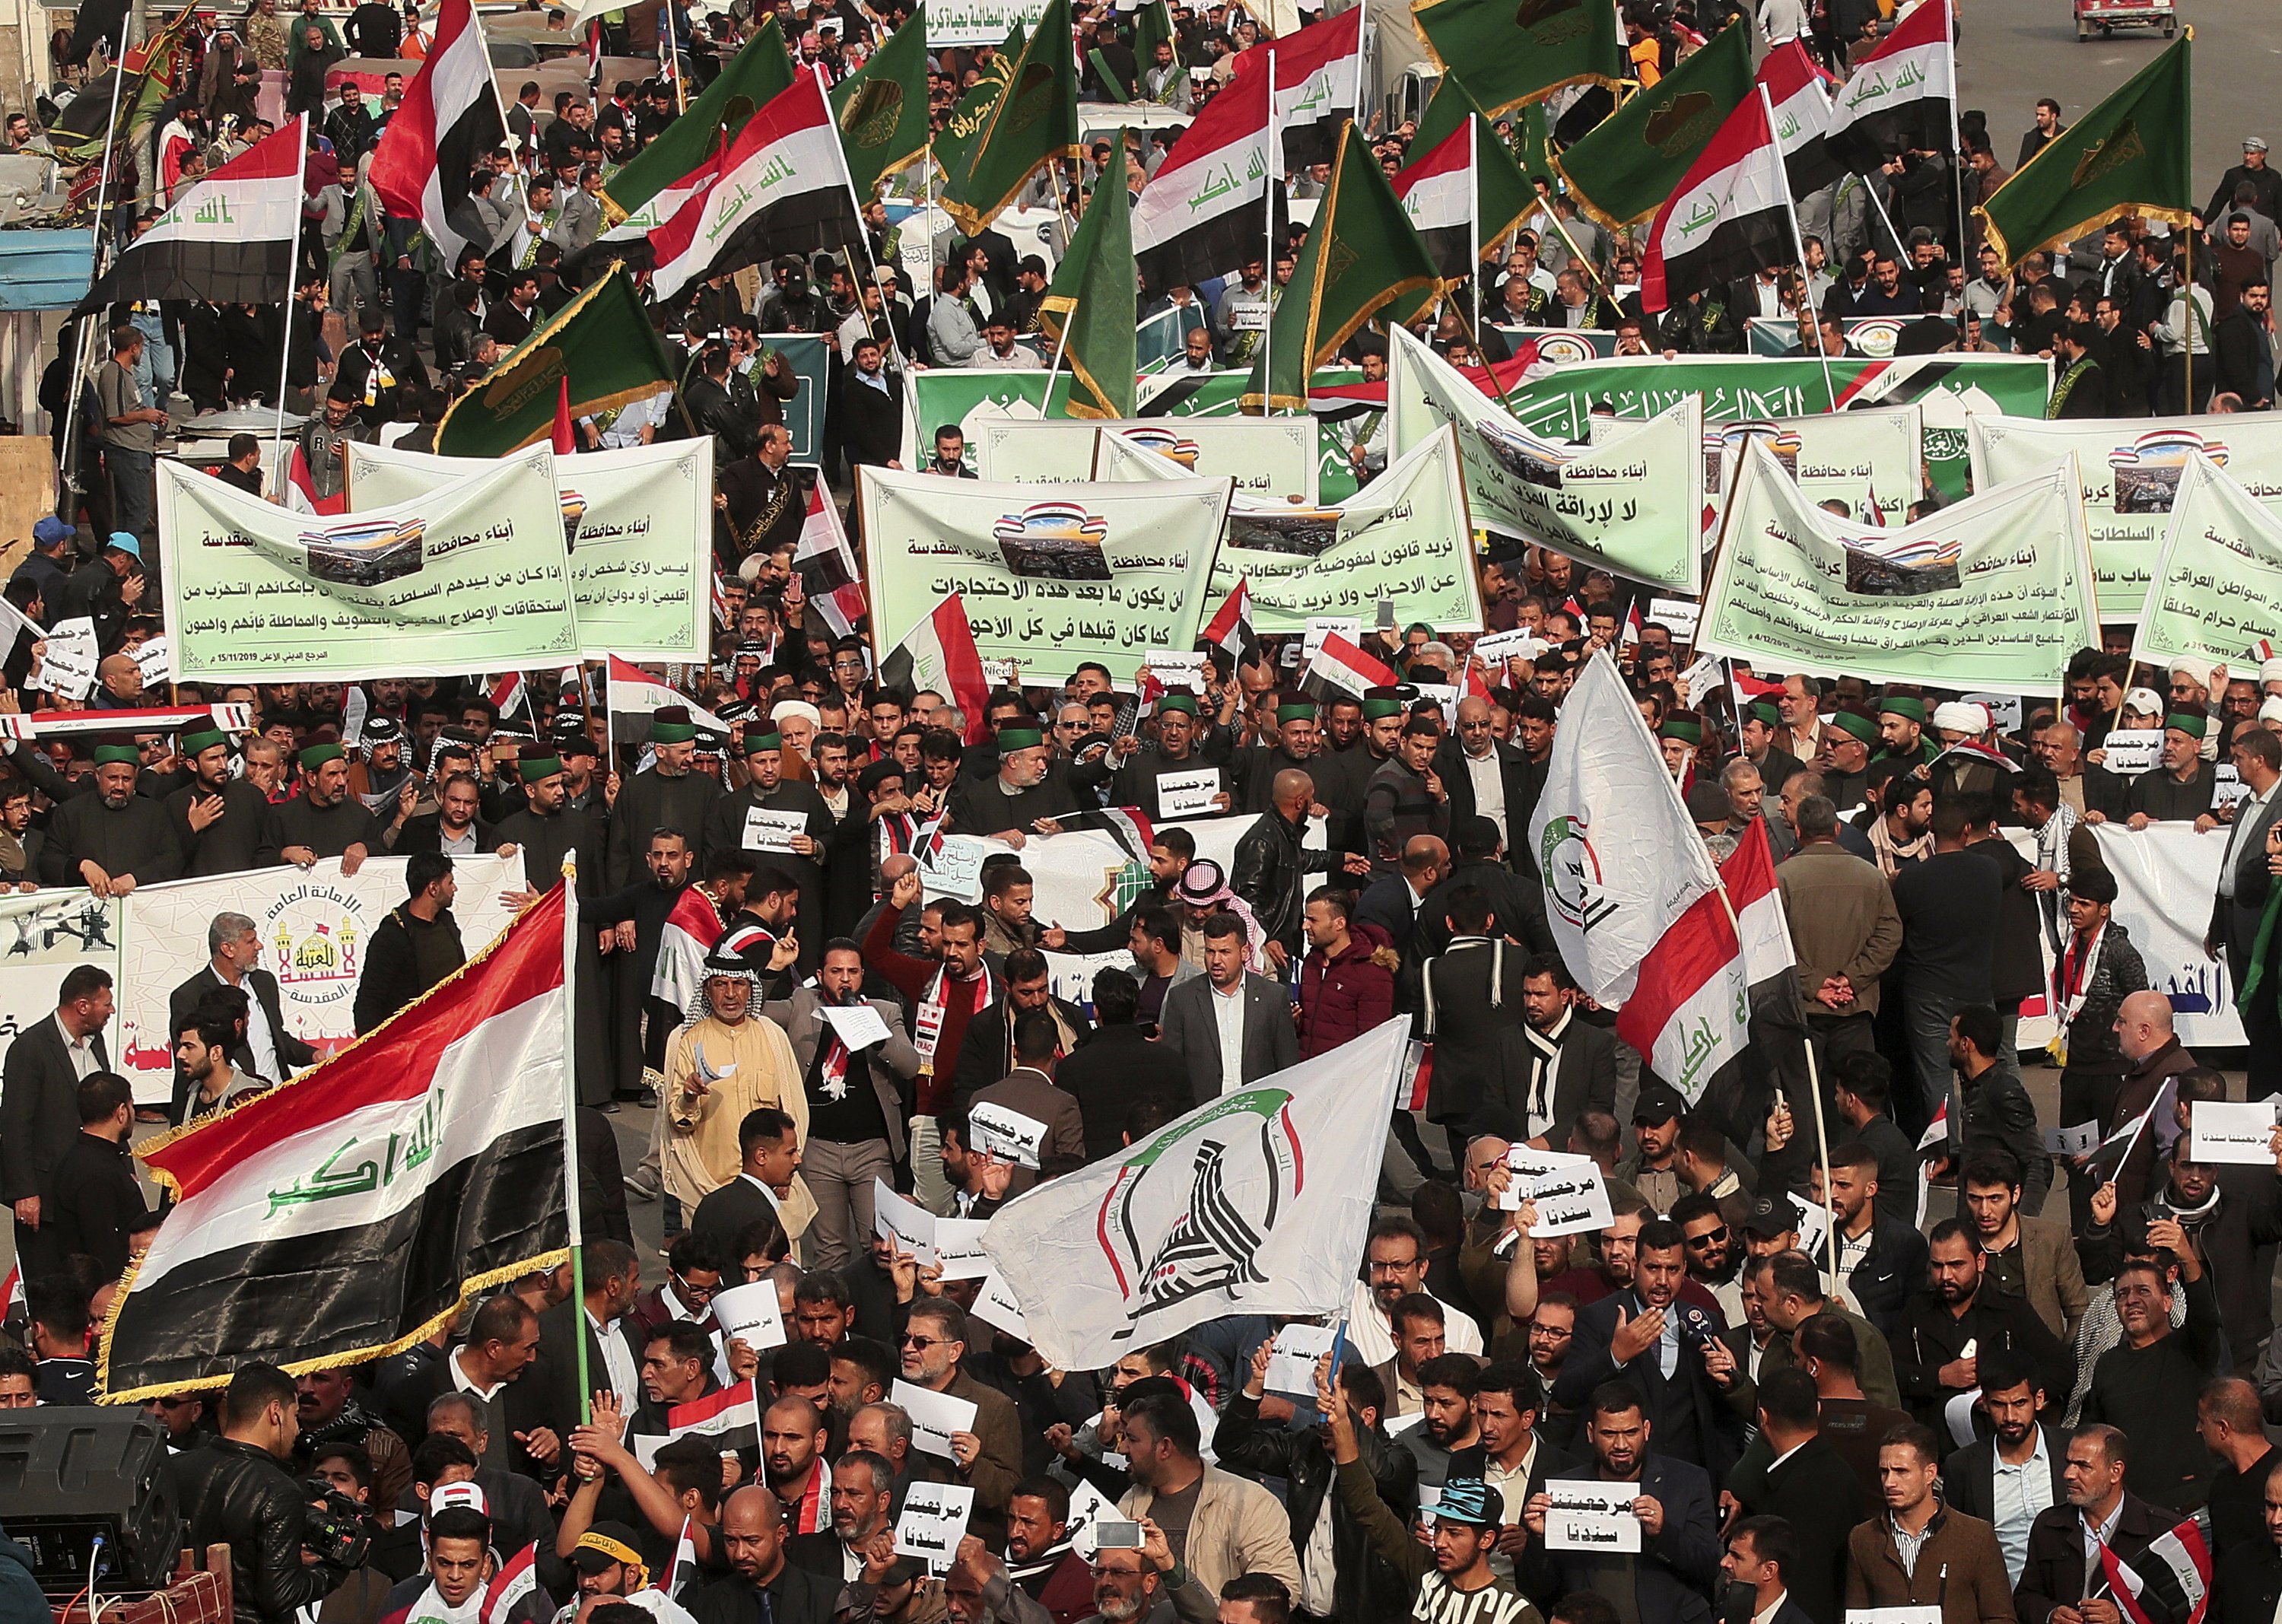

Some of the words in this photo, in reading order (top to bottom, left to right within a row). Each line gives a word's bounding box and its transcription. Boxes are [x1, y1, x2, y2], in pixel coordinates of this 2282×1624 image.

[1565, 464, 1617, 480] محافظة
[1622, 459, 1648, 481] أبناء
[1801, 464, 1846, 478] محافظة
[1851, 462, 1873, 480] أبناء
[1388, 499, 1413, 522] أبناء
[1620, 497, 1637, 523] لا
[485, 518, 513, 542] أبناء
[579, 522, 623, 540] محافظة
[627, 513, 650, 537] أبناء
[2090, 525, 2155, 542] السلطات
[427, 532, 480, 557] محافظة
[907, 538, 962, 557] المقدسة
[966, 546, 1002, 563] كربلاء
[1381, 542, 1419, 567] قانون
[1425, 536, 1453, 559] نريد
[1111, 554, 1165, 570] محافظة
[1168, 549, 1189, 570] أبناء
[1314, 549, 1376, 576] لمفوضية
[1810, 554, 1842, 575] كربلاء
[2010, 544, 2037, 570] أبناء
[494, 572, 511, 586] من
[590, 560, 626, 579] شخص
[2169, 567, 2215, 587] العراقي
[183, 584, 201, 601] من
[1035, 582, 1069, 599] هذه
[1108, 584, 1121, 602] ما
[1431, 572, 1456, 593] عن
[2217, 580, 2268, 602] المواطن
[389, 583, 441, 607] السلطة
[1075, 586, 1104, 608] بعد
[1127, 585, 1165, 612] يكون
[1169, 589, 1184, 612] لن
[1302, 588, 1332, 611] نريد
[1339, 586, 1359, 607] ولا
[450, 605, 498, 626] الإصلاح
[503, 599, 567, 617] استحقاقات
[2203, 609, 2236, 628] حرام
[185, 618, 227, 635] واهمون
[269, 613, 327, 631] والمماطلة
[1050, 616, 1075, 648] في
[1079, 618, 1116, 640] قبلها
[2239, 620, 2277, 638] مسلم
[1121, 624, 1147, 647] كان
[1150, 624, 1170, 646] كما
[218, 652, 257, 662] 15/11/2019
[2106, 736, 2159, 752] مرجعيتنا
[2115, 755, 2150, 769] سندنا
[1160, 780, 1215, 794] مرجعيتنا
[1173, 798, 1207, 811] سندنا
[748, 813, 802, 833] مرجعيتنا
[290, 983, 349, 1005] المقدسة
[916, 1041, 933, 1053] IRAQ
[971, 1108, 1035, 1146] مرجعيتنا
[2202, 1133, 2227, 1143] سندنا
[2229, 1134, 2268, 1146] مرجعيتنا
[1533, 1177, 1595, 1202] مرجعيتنا
[1546, 1206, 1592, 1226] سندنا
[1549, 1489, 1632, 1516] مرجعيتنا
[905, 1525, 946, 1551] سندنا
[1567, 1522, 1619, 1543] سندنا
